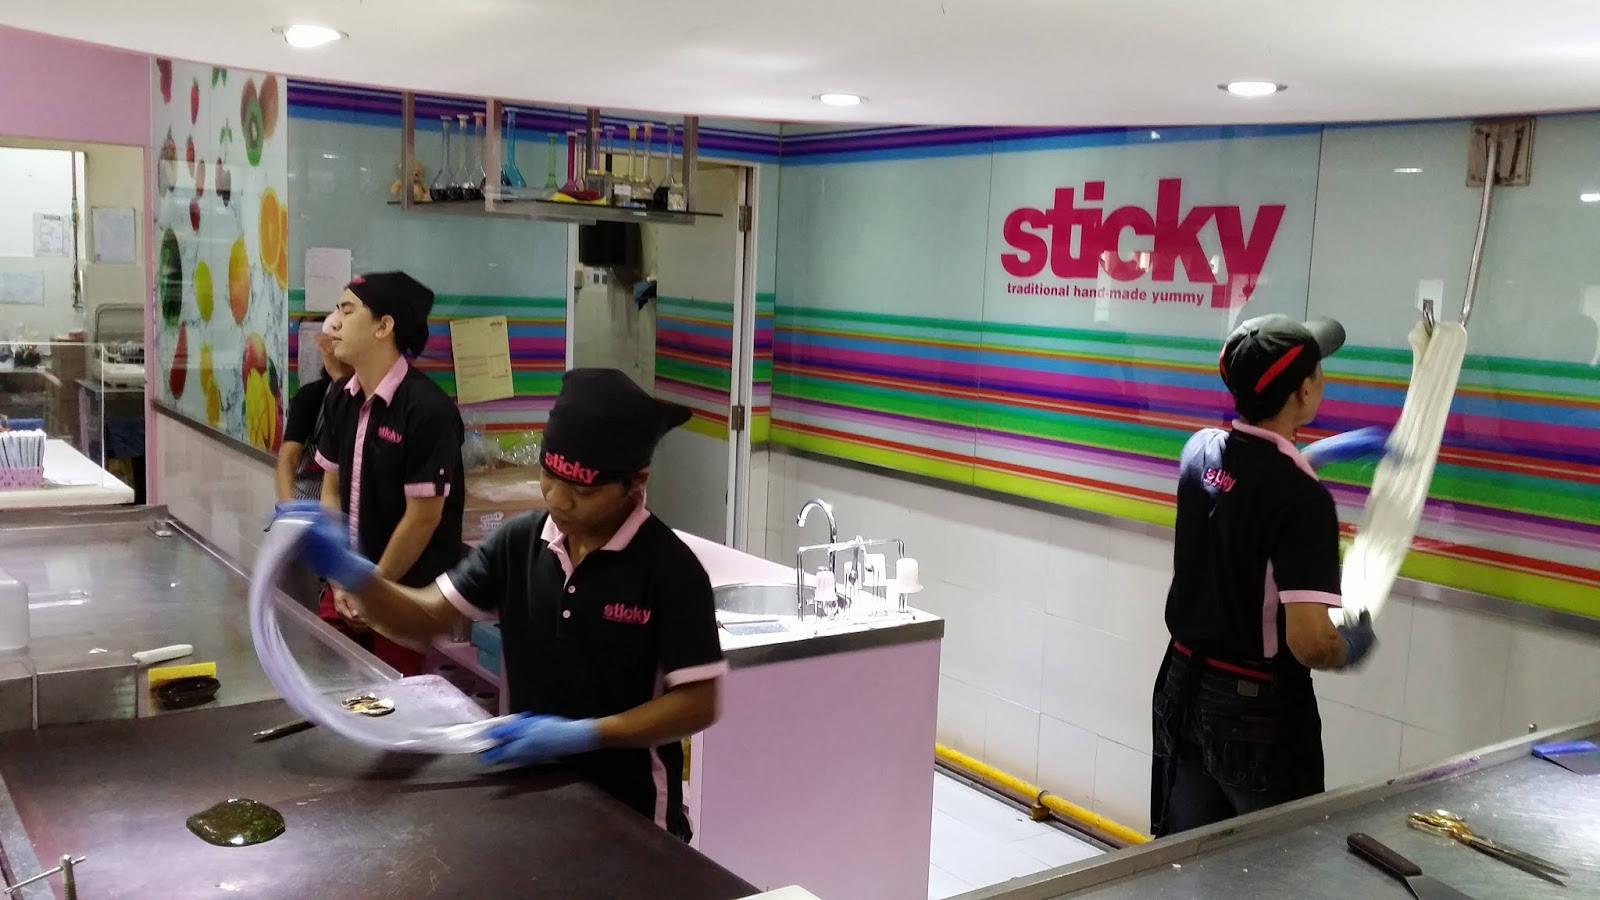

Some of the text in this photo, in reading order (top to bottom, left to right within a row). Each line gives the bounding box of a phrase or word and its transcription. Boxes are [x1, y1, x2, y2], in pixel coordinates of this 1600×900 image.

[1000, 178, 1286, 309] sticky
[1007, 282, 1205, 306] traditional hand-made yummy
[544, 452, 599, 484] sticky
[603, 603, 651, 625] sticky
